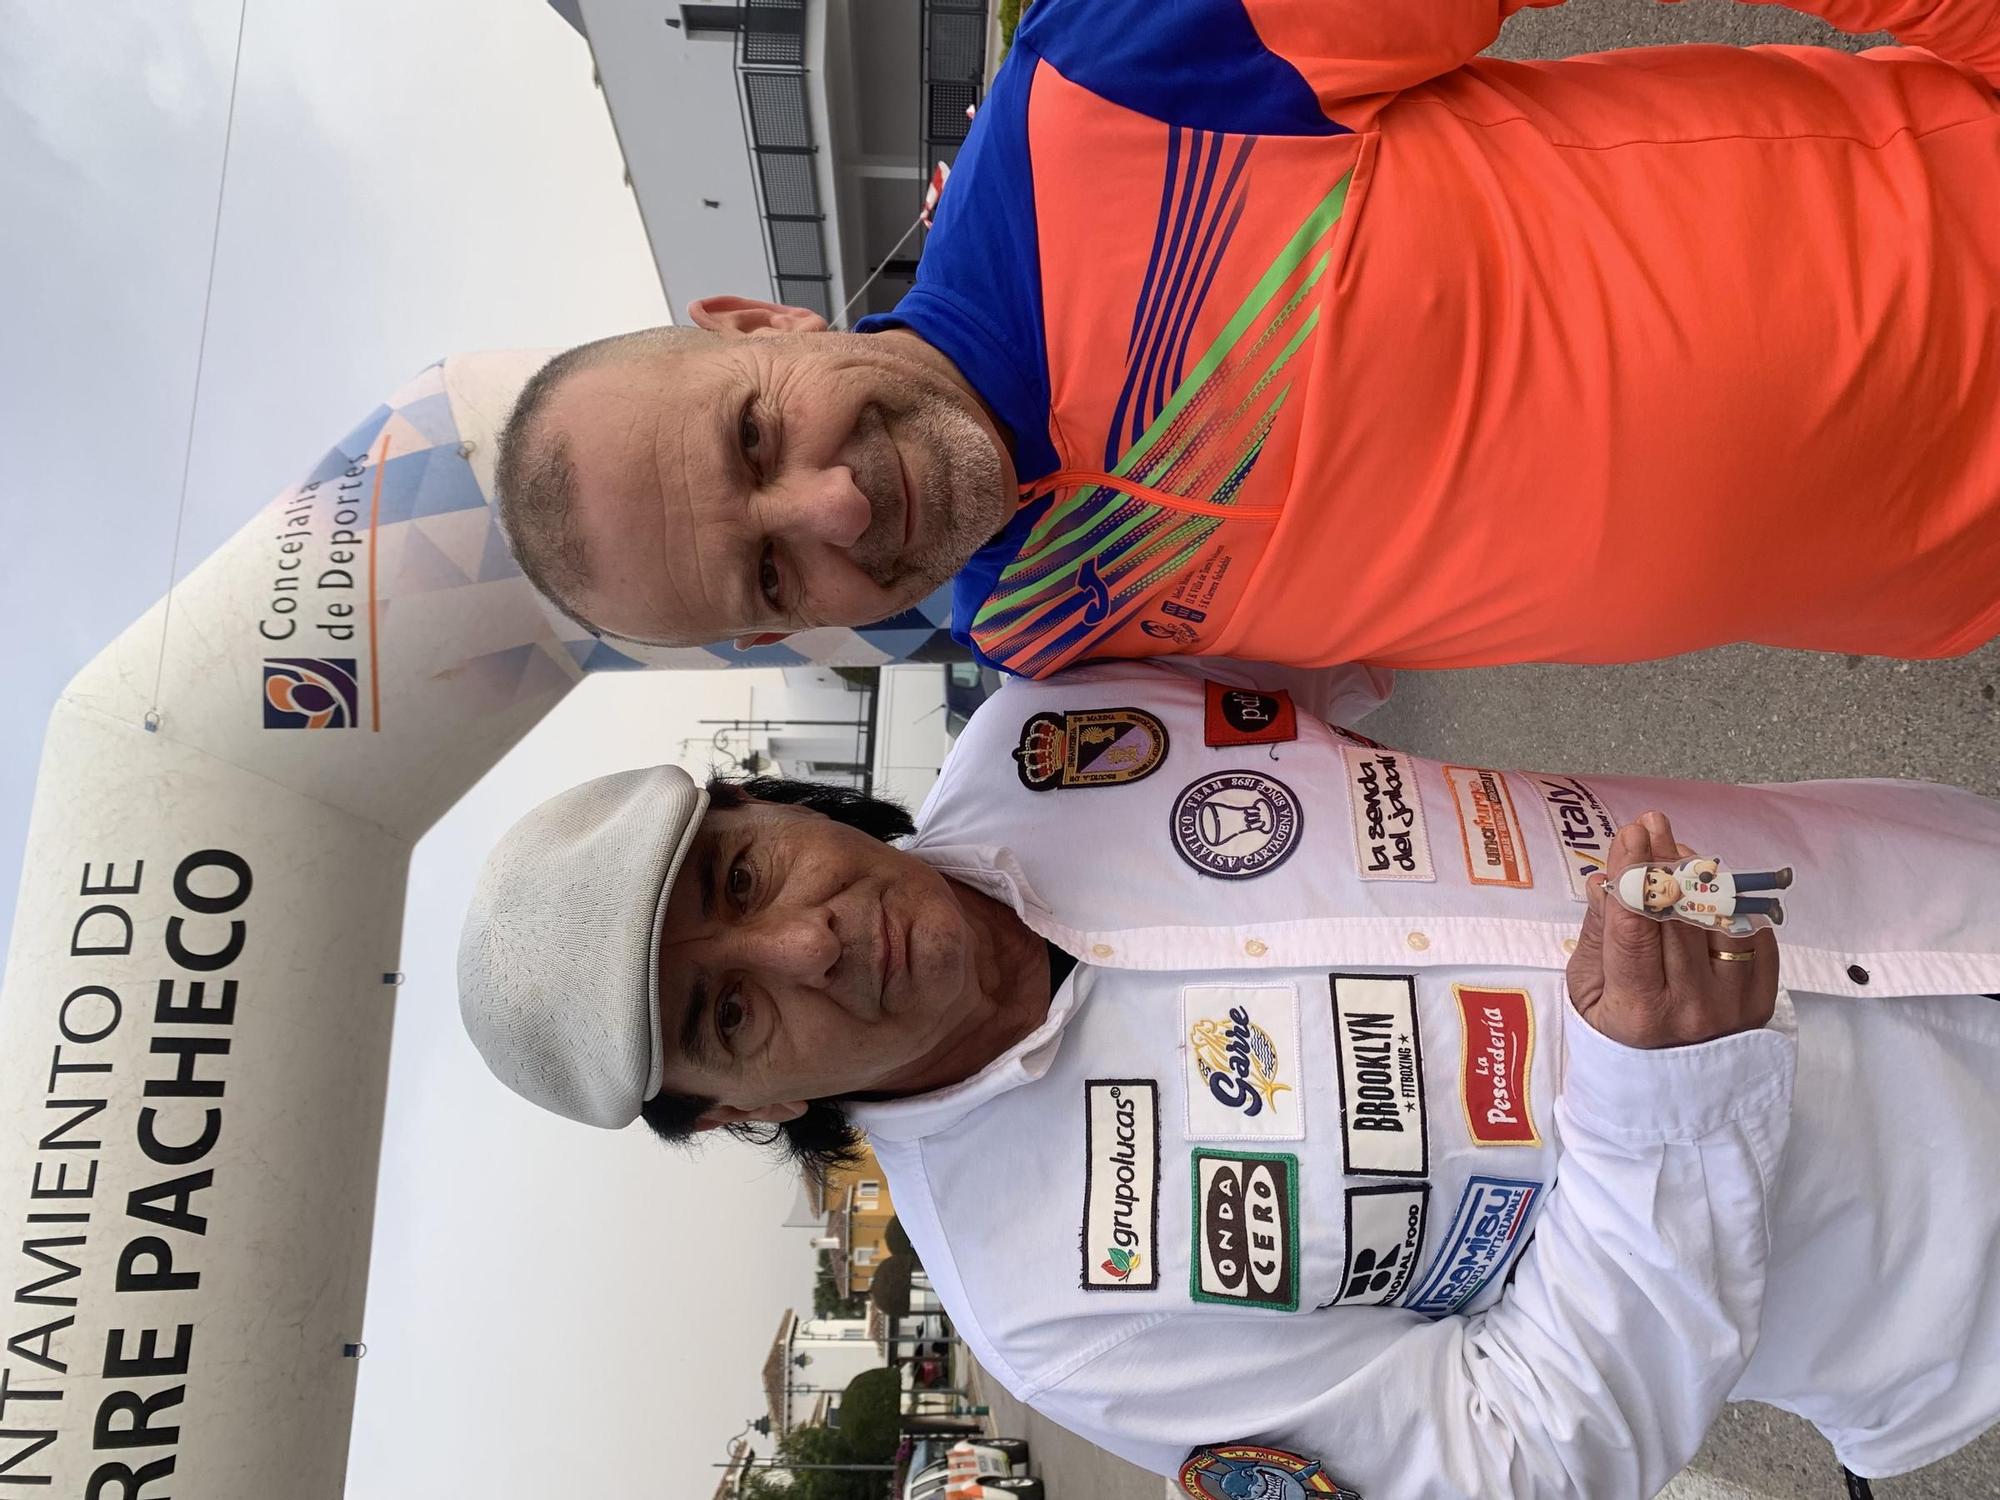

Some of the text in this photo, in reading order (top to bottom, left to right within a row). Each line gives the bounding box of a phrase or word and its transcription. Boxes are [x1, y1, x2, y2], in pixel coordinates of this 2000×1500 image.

[316, 454, 368, 641] de Deportes
[1185, 780, 1223, 808] TEAM
[1231, 777, 1291, 866] CARTAGENA SINCE 1898
[1357, 761, 1391, 871] la senda
[1374, 753, 1416, 871] del jabalí
[1596, 814, 1616, 838] Salud
[114, 848, 254, 1293] PACHECO
[1208, 1005, 1263, 1117] Garre
[1343, 1012, 1404, 1132] BROOKLYN
[1398, 1047, 1416, 1098] FITBOXING
[1475, 1056, 1490, 1075] La
[1480, 1007, 1519, 1125] Pescadería
[0, 859, 144, 1500] NTAMIENTO DE
[1216, 1177, 1238, 1278] ONDA
[1251, 1180, 1276, 1276] CERO
[1483, 1189, 1526, 1263] ARTIGIANALE
[1382, 1204, 1419, 1303] TIONAL FOOD
